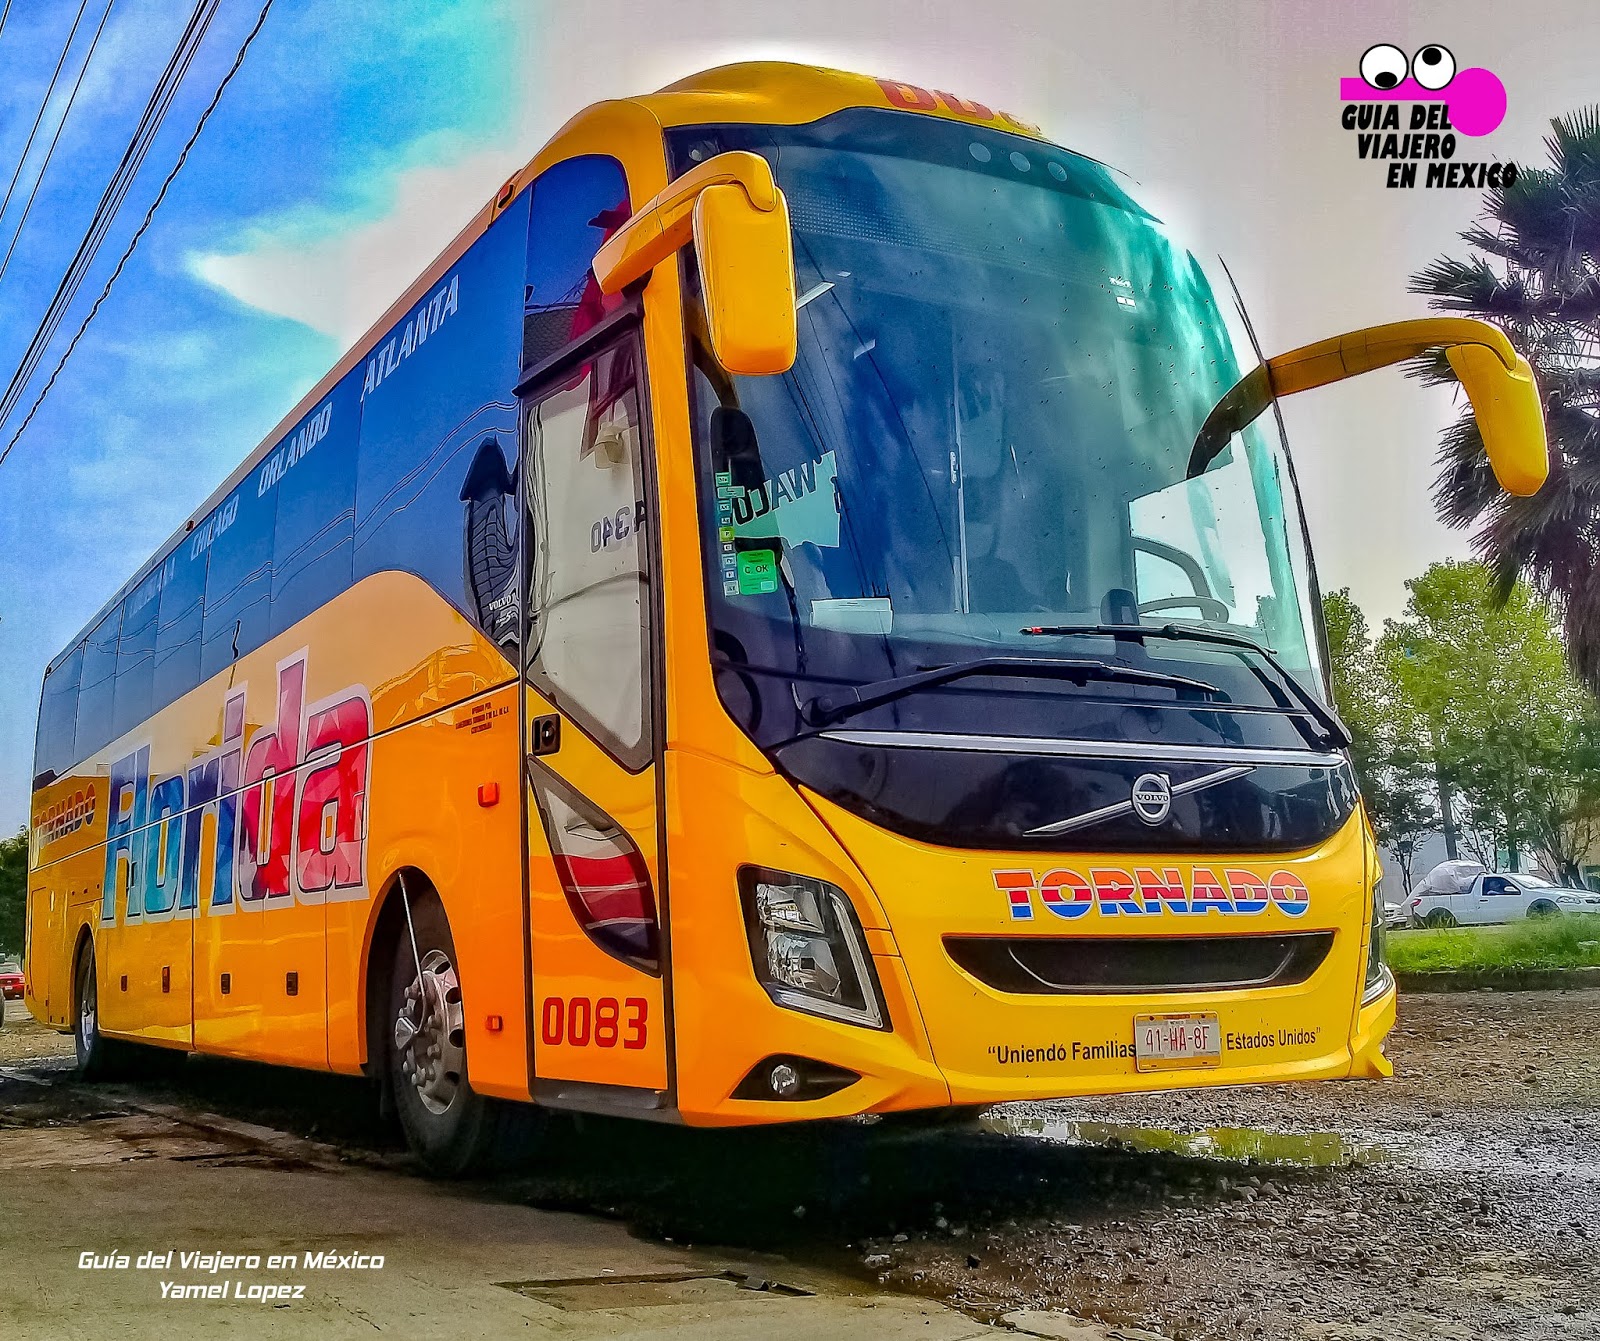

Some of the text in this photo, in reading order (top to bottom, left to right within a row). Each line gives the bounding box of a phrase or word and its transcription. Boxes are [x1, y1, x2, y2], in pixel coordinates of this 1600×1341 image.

[359, 274, 459, 403] ATLANTA
[257, 401, 333, 498] ORLANDO
[190, 493, 240, 562] CHICAGO
[1135, 793, 1169, 802] VOLVO
[991, 867, 1311, 921] TORNADO
[541, 997, 648, 1050] 0083
[1145, 1025, 1210, 1052] 41-HA-8F
[1226, 1031, 1275, 1050] Estados
[1072, 1040, 1136, 1061] Familias
